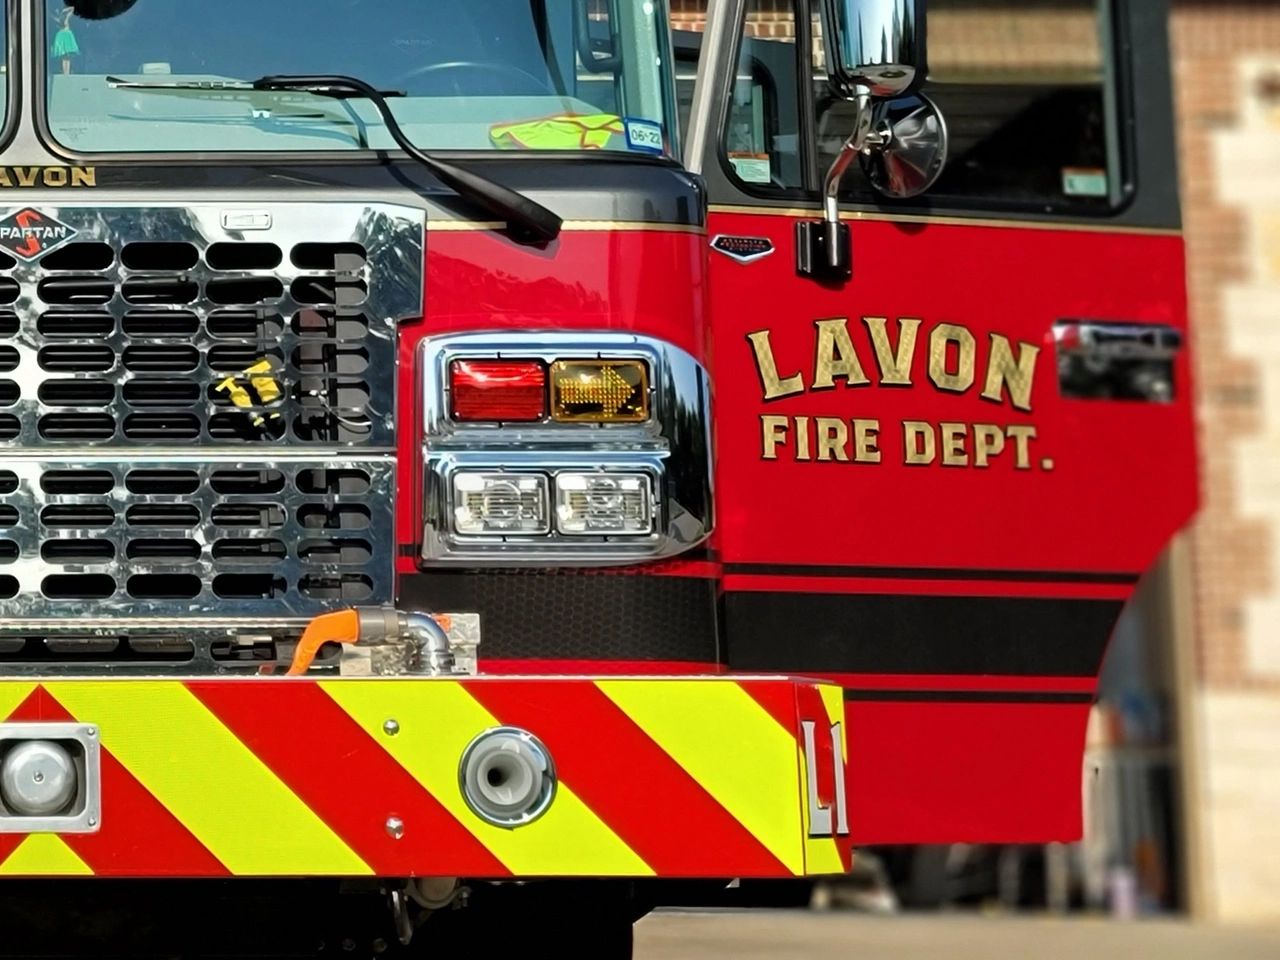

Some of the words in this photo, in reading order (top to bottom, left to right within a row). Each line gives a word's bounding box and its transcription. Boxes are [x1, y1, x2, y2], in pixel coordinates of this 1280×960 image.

[746, 316, 1041, 412] LAVON
[760, 414, 882, 465] FIRE
[902, 419, 1055, 471] DEPT.
